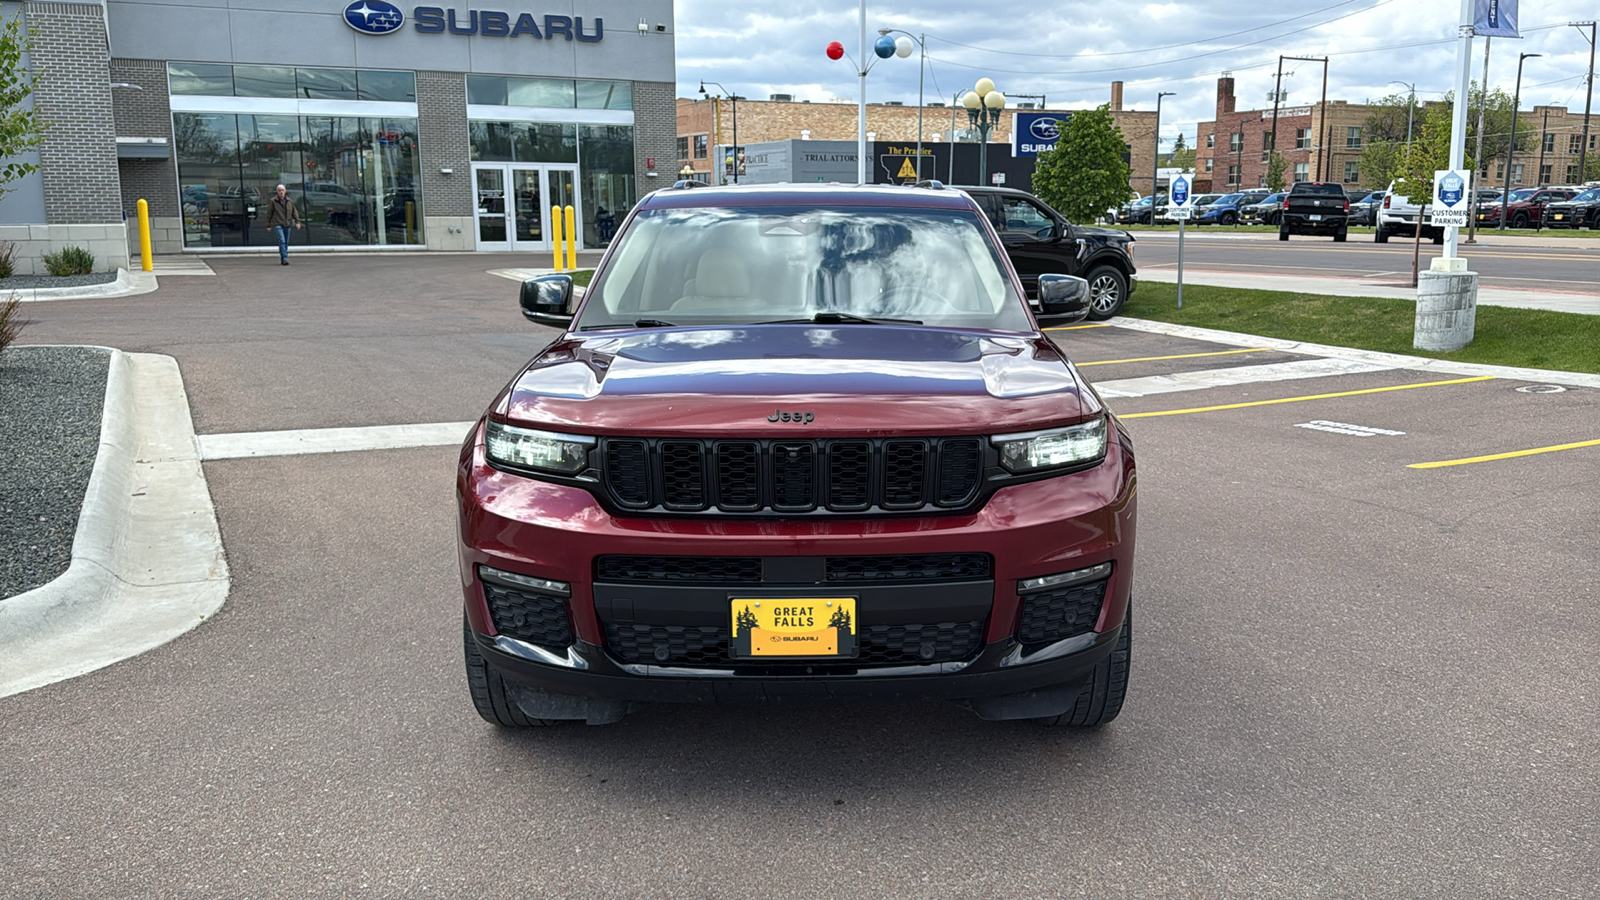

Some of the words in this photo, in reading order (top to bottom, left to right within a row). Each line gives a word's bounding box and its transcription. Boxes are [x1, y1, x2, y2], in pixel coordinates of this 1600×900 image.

[414, 6, 604, 42] SUBARU
[888, 146, 902, 155] The
[1021, 143, 1057, 152] SUBA
[805, 154, 828, 162] TRIAL
[829, 154, 874, 162] ATTORNYS
[1434, 217, 1463, 225] PARKING
[767, 409, 814, 425] Jeep
[774, 607, 814, 616] GREAT
[774, 617, 814, 626] FALLS
